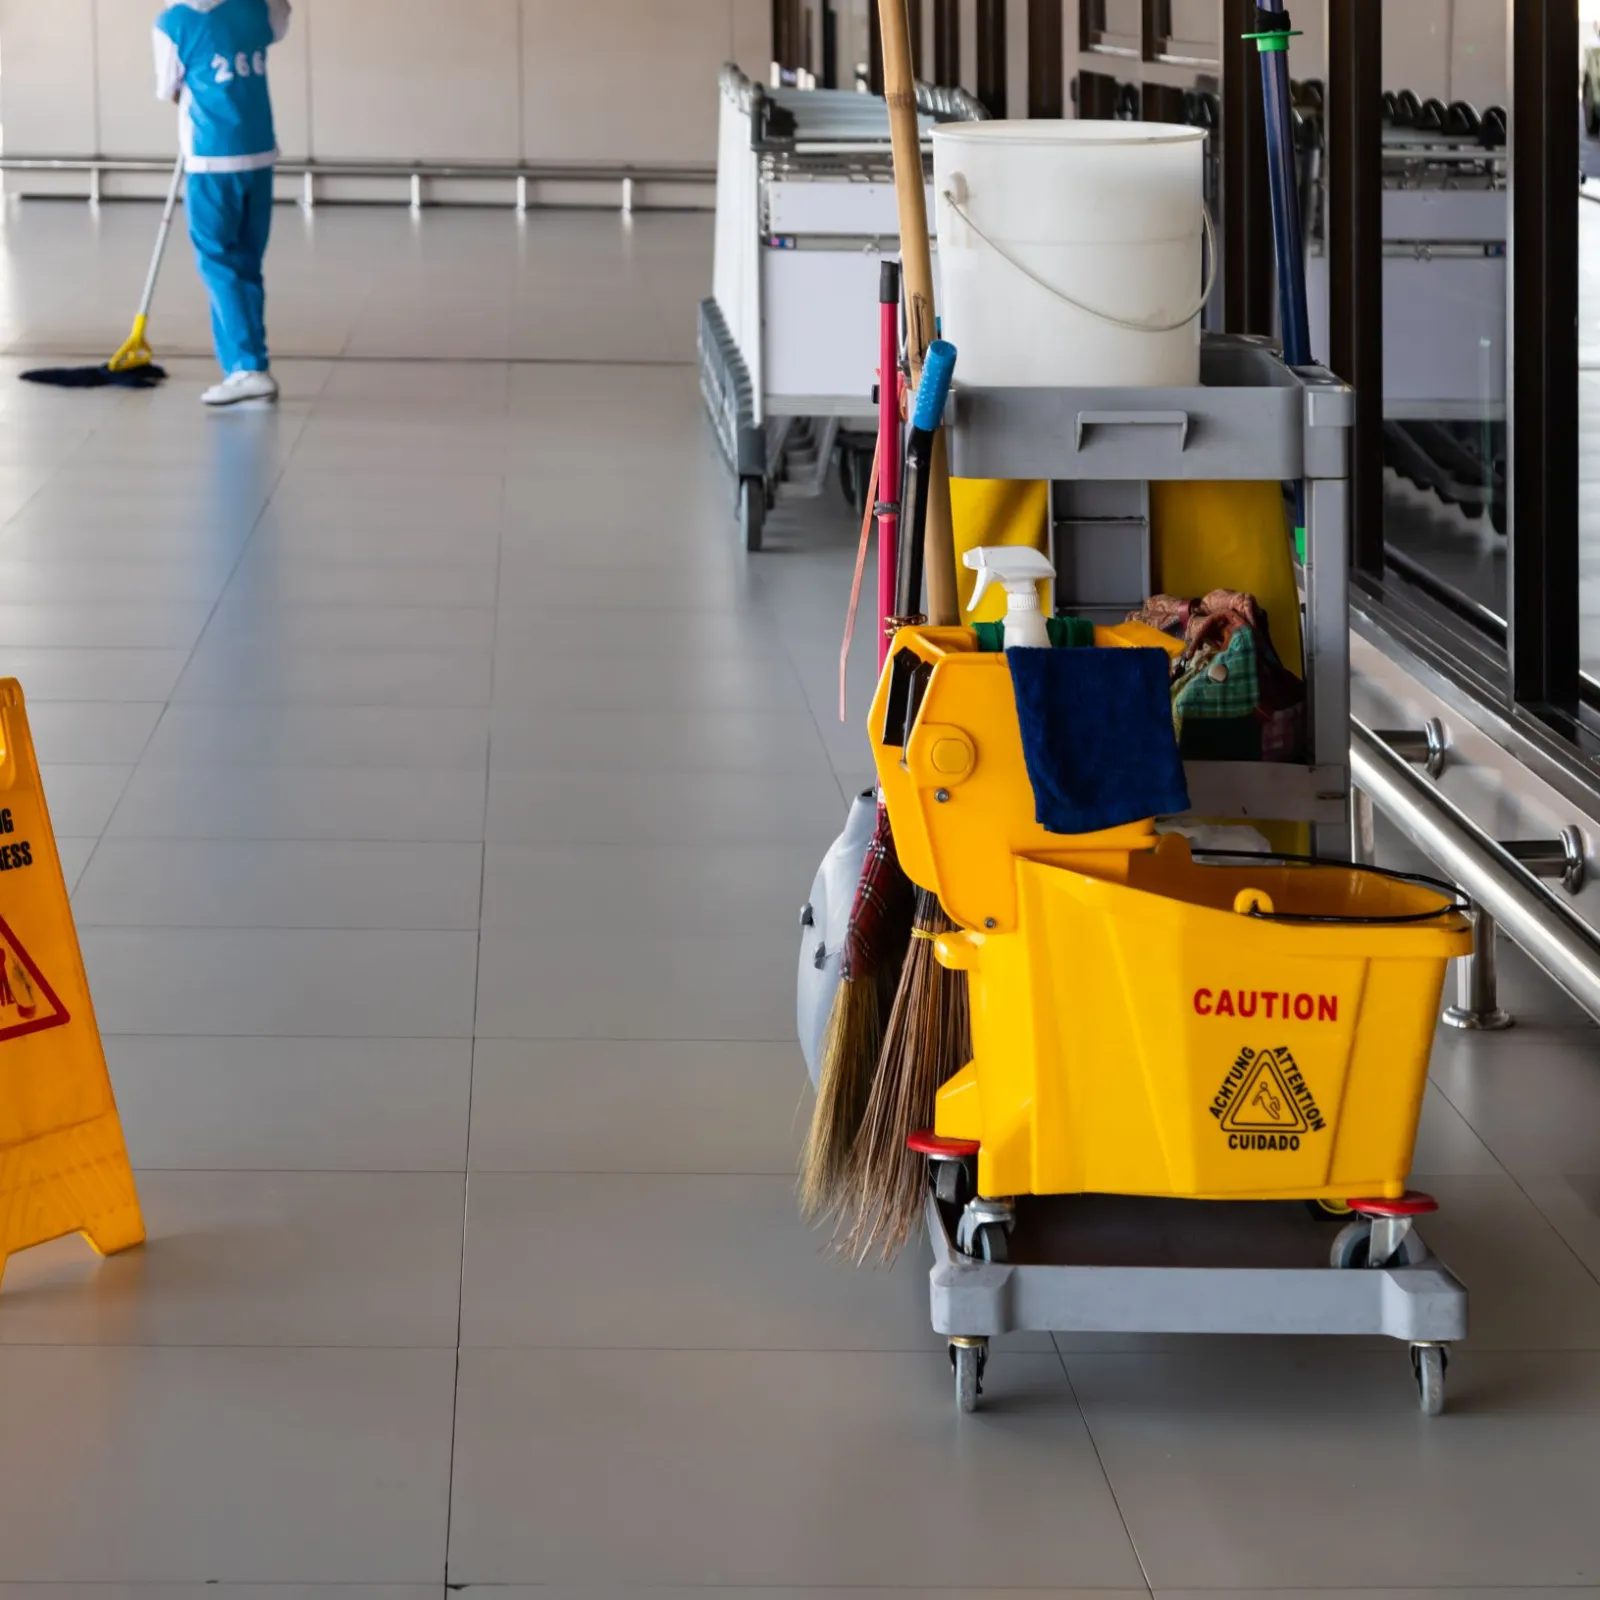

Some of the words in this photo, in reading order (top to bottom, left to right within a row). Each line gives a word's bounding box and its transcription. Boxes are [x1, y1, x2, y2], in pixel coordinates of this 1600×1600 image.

[1193, 988, 1338, 1021] CAUTION
[1209, 1046, 1255, 1119] ACHTUNG
[1274, 1046, 1327, 1132] ATTENTION
[1228, 1134, 1300, 1151] CUIDADO
